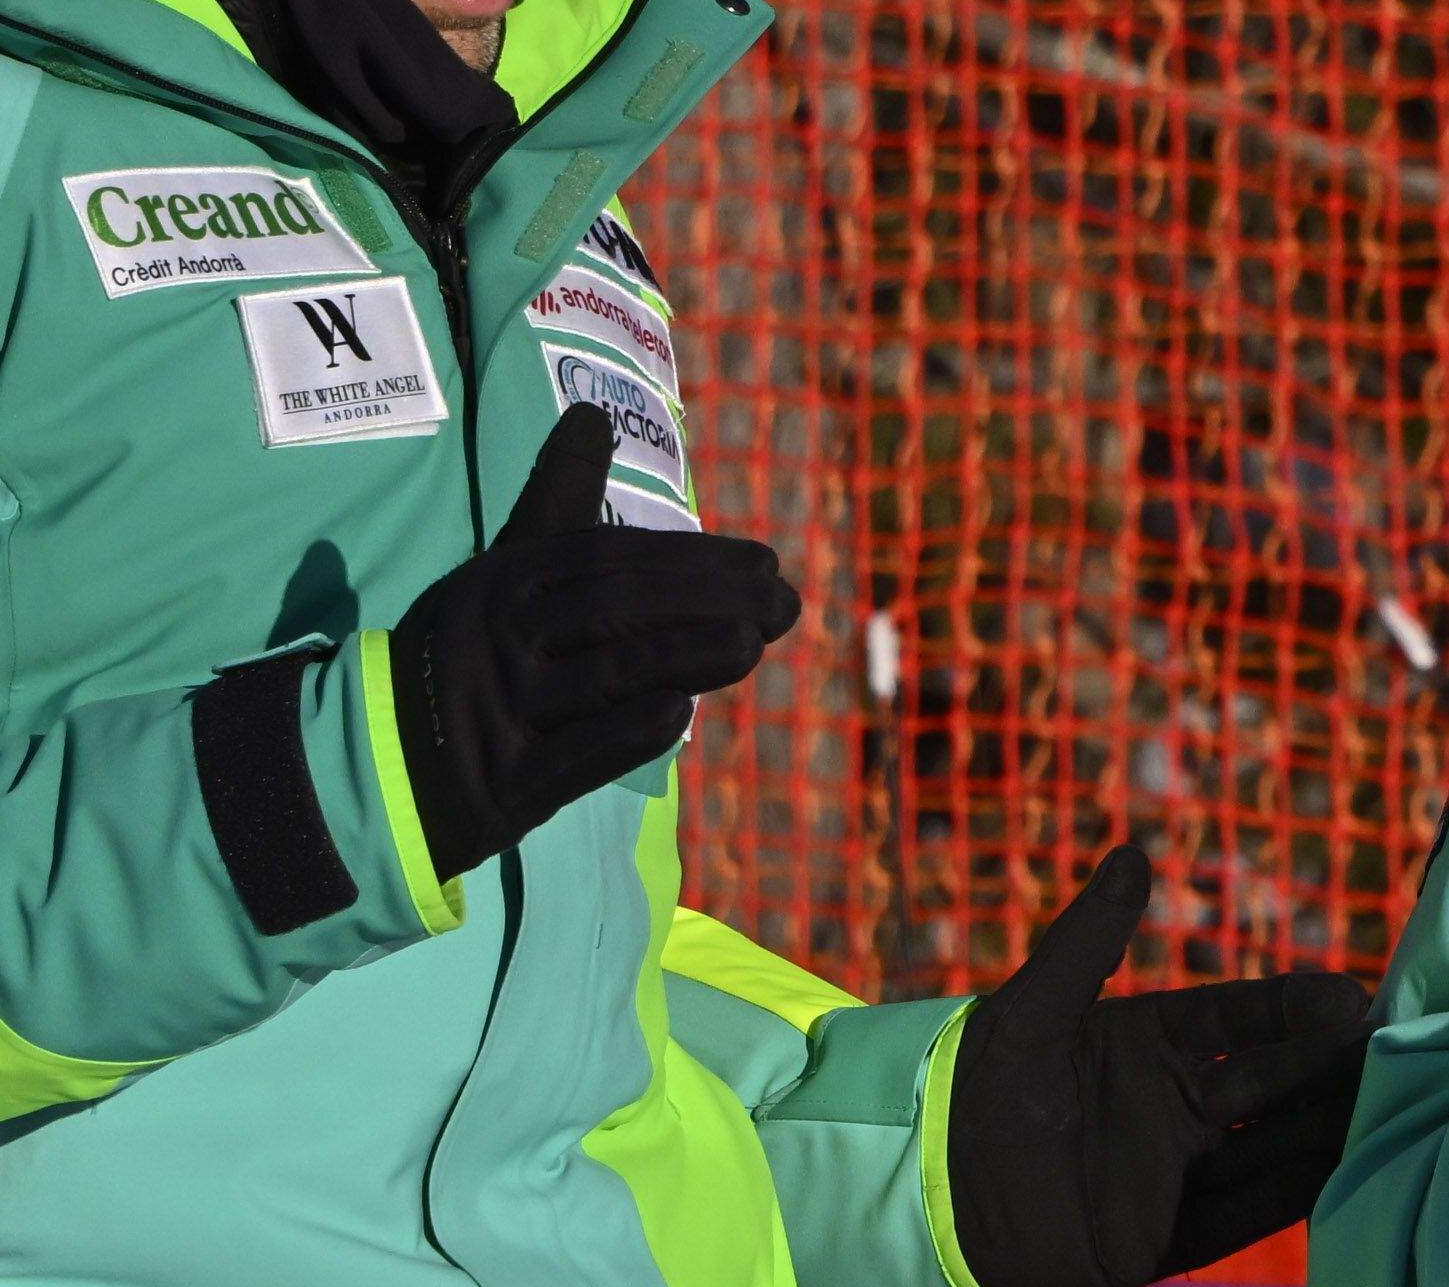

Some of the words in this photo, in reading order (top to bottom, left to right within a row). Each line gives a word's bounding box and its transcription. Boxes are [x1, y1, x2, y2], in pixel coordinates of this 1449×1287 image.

[86, 181, 325, 248] Creand
[111, 257, 174, 287] Crèdit
[179, 255, 247, 276] Andorrà
[279, 390, 311, 411] THE
[315, 383, 371, 405] WHITE
[375, 375, 426, 397] ANGEL
[324, 404, 392, 423] ANDORRA
